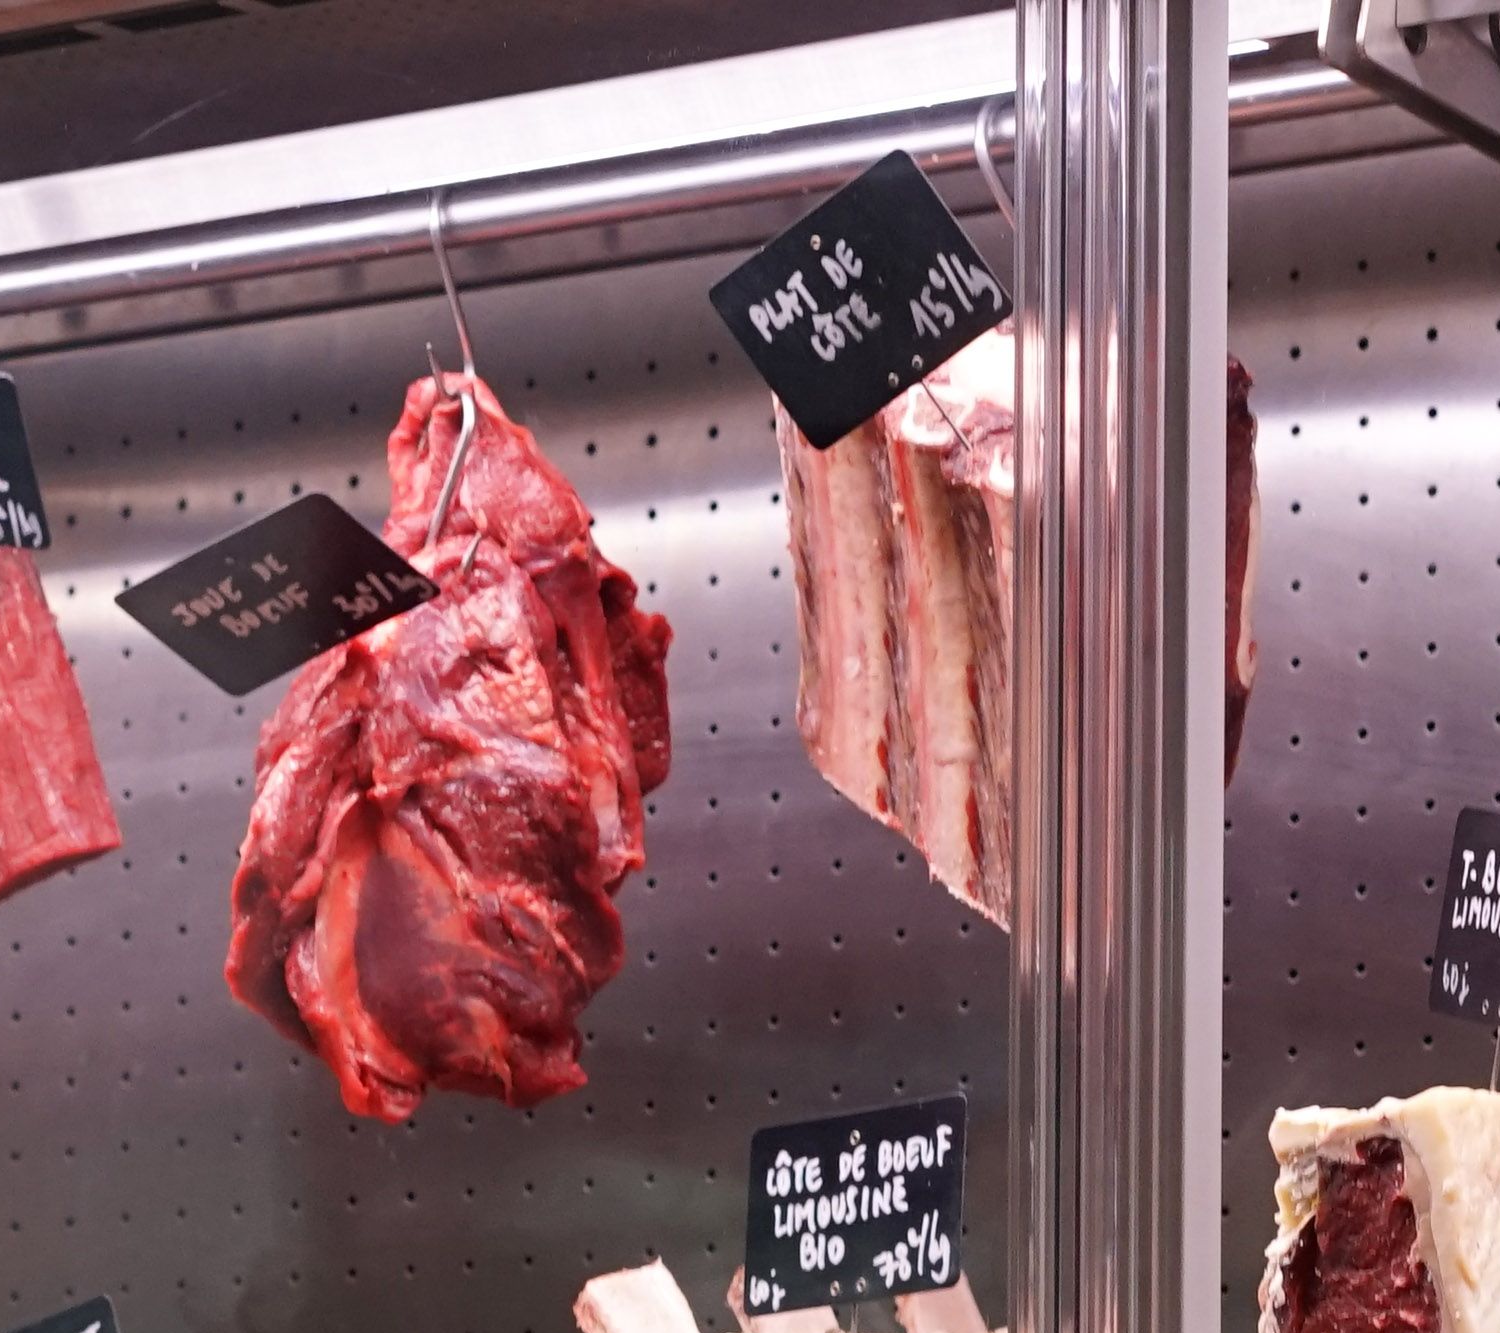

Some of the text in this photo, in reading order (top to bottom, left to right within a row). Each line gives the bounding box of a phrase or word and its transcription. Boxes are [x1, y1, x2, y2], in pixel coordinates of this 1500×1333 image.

[749, 238, 863, 344] PLAT DE
[171, 553, 288, 627] JOUE DE
[219, 581, 309, 638] BOEUF
[766, 1124, 952, 1197] CÔTE DE BOEUF
[774, 1175, 909, 1238] LIMOUSINE
[800, 1231, 846, 1271] BIO
